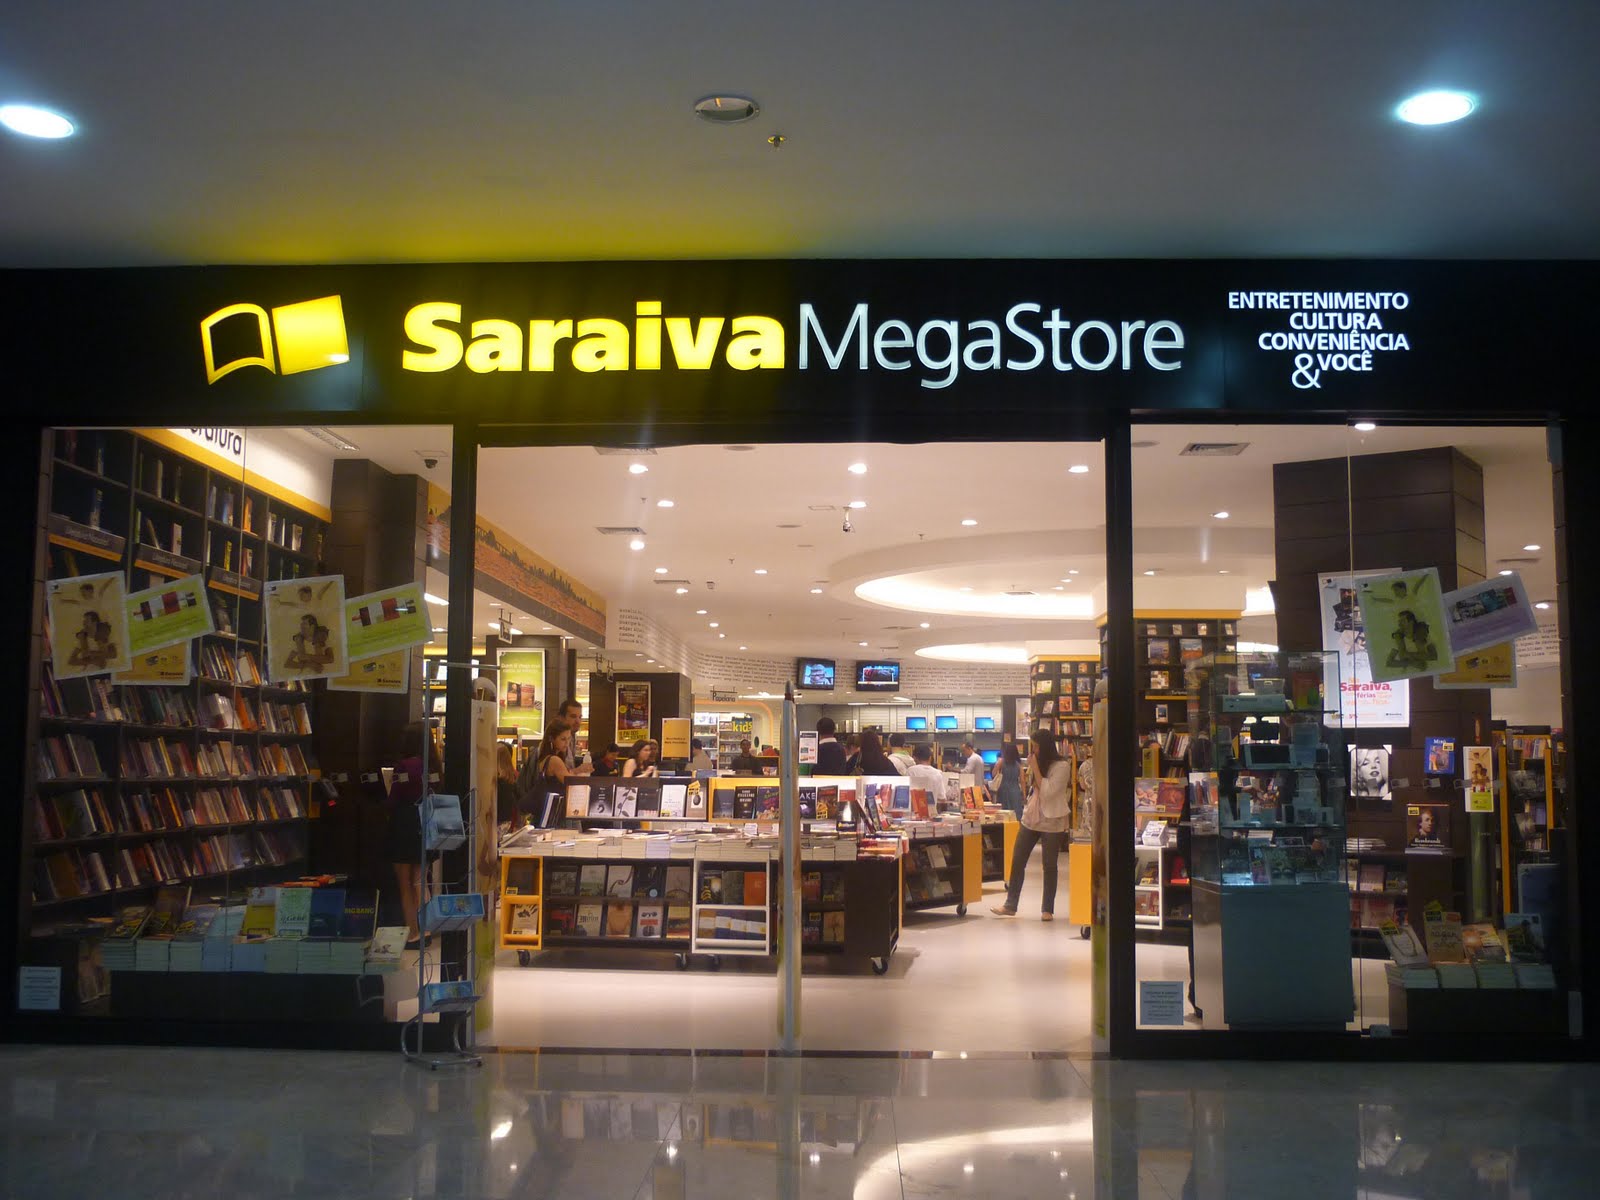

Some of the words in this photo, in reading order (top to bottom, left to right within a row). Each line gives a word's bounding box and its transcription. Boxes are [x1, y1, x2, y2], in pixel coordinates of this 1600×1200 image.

[1228, 291, 1409, 310] ENTRETENIMENTO
[1289, 312, 1382, 330] CULTURA
[402, 301, 785, 373] Saraiva
[799, 302, 1185, 389] MegaStore
[1258, 329, 1410, 351] CONVENIÊNCIA
[1291, 354, 1321, 389] &
[1318, 350, 1373, 372] VOCÊ
[1340, 681, 1392, 691] Saraiva,
[732, 721, 752, 733] kids
